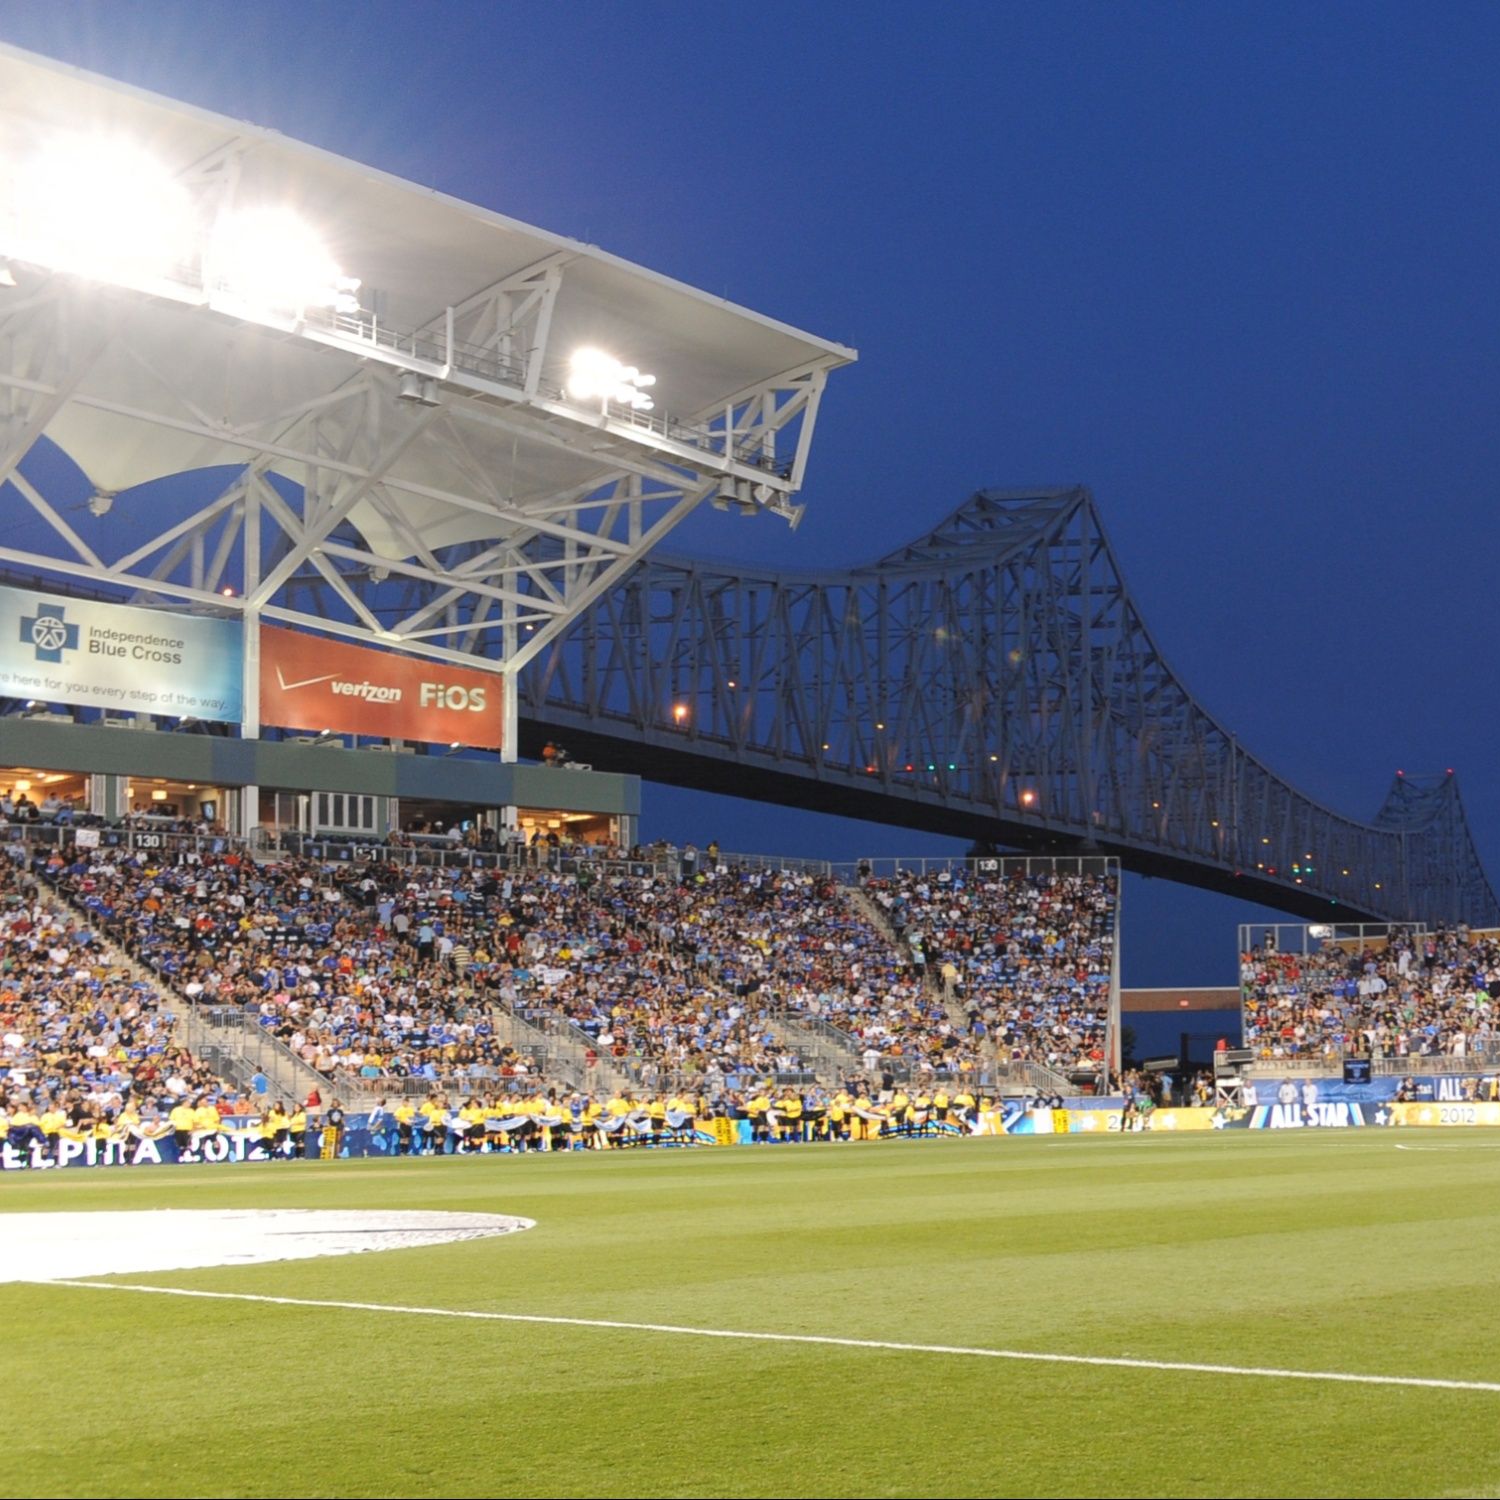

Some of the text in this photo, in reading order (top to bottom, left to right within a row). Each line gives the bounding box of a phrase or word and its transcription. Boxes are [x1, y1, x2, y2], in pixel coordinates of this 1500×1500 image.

[89, 626, 185, 649] Independence
[89, 639, 182, 665] Blue Cross
[13, 672, 41, 688] here
[44, 677, 62, 689] for
[65, 682, 89, 694] you
[92, 686, 127, 700] every
[129, 688, 157, 703] step
[161, 692, 174, 703] of
[177, 694, 197, 706] the
[331, 681, 487, 712] verizon FiOS
[135, 834, 160, 849] 130
[1438, 1077, 1463, 1101] ALL
[1269, 1102, 1349, 1129] ALL STAR
[1440, 1107, 1475, 1124] 2012
